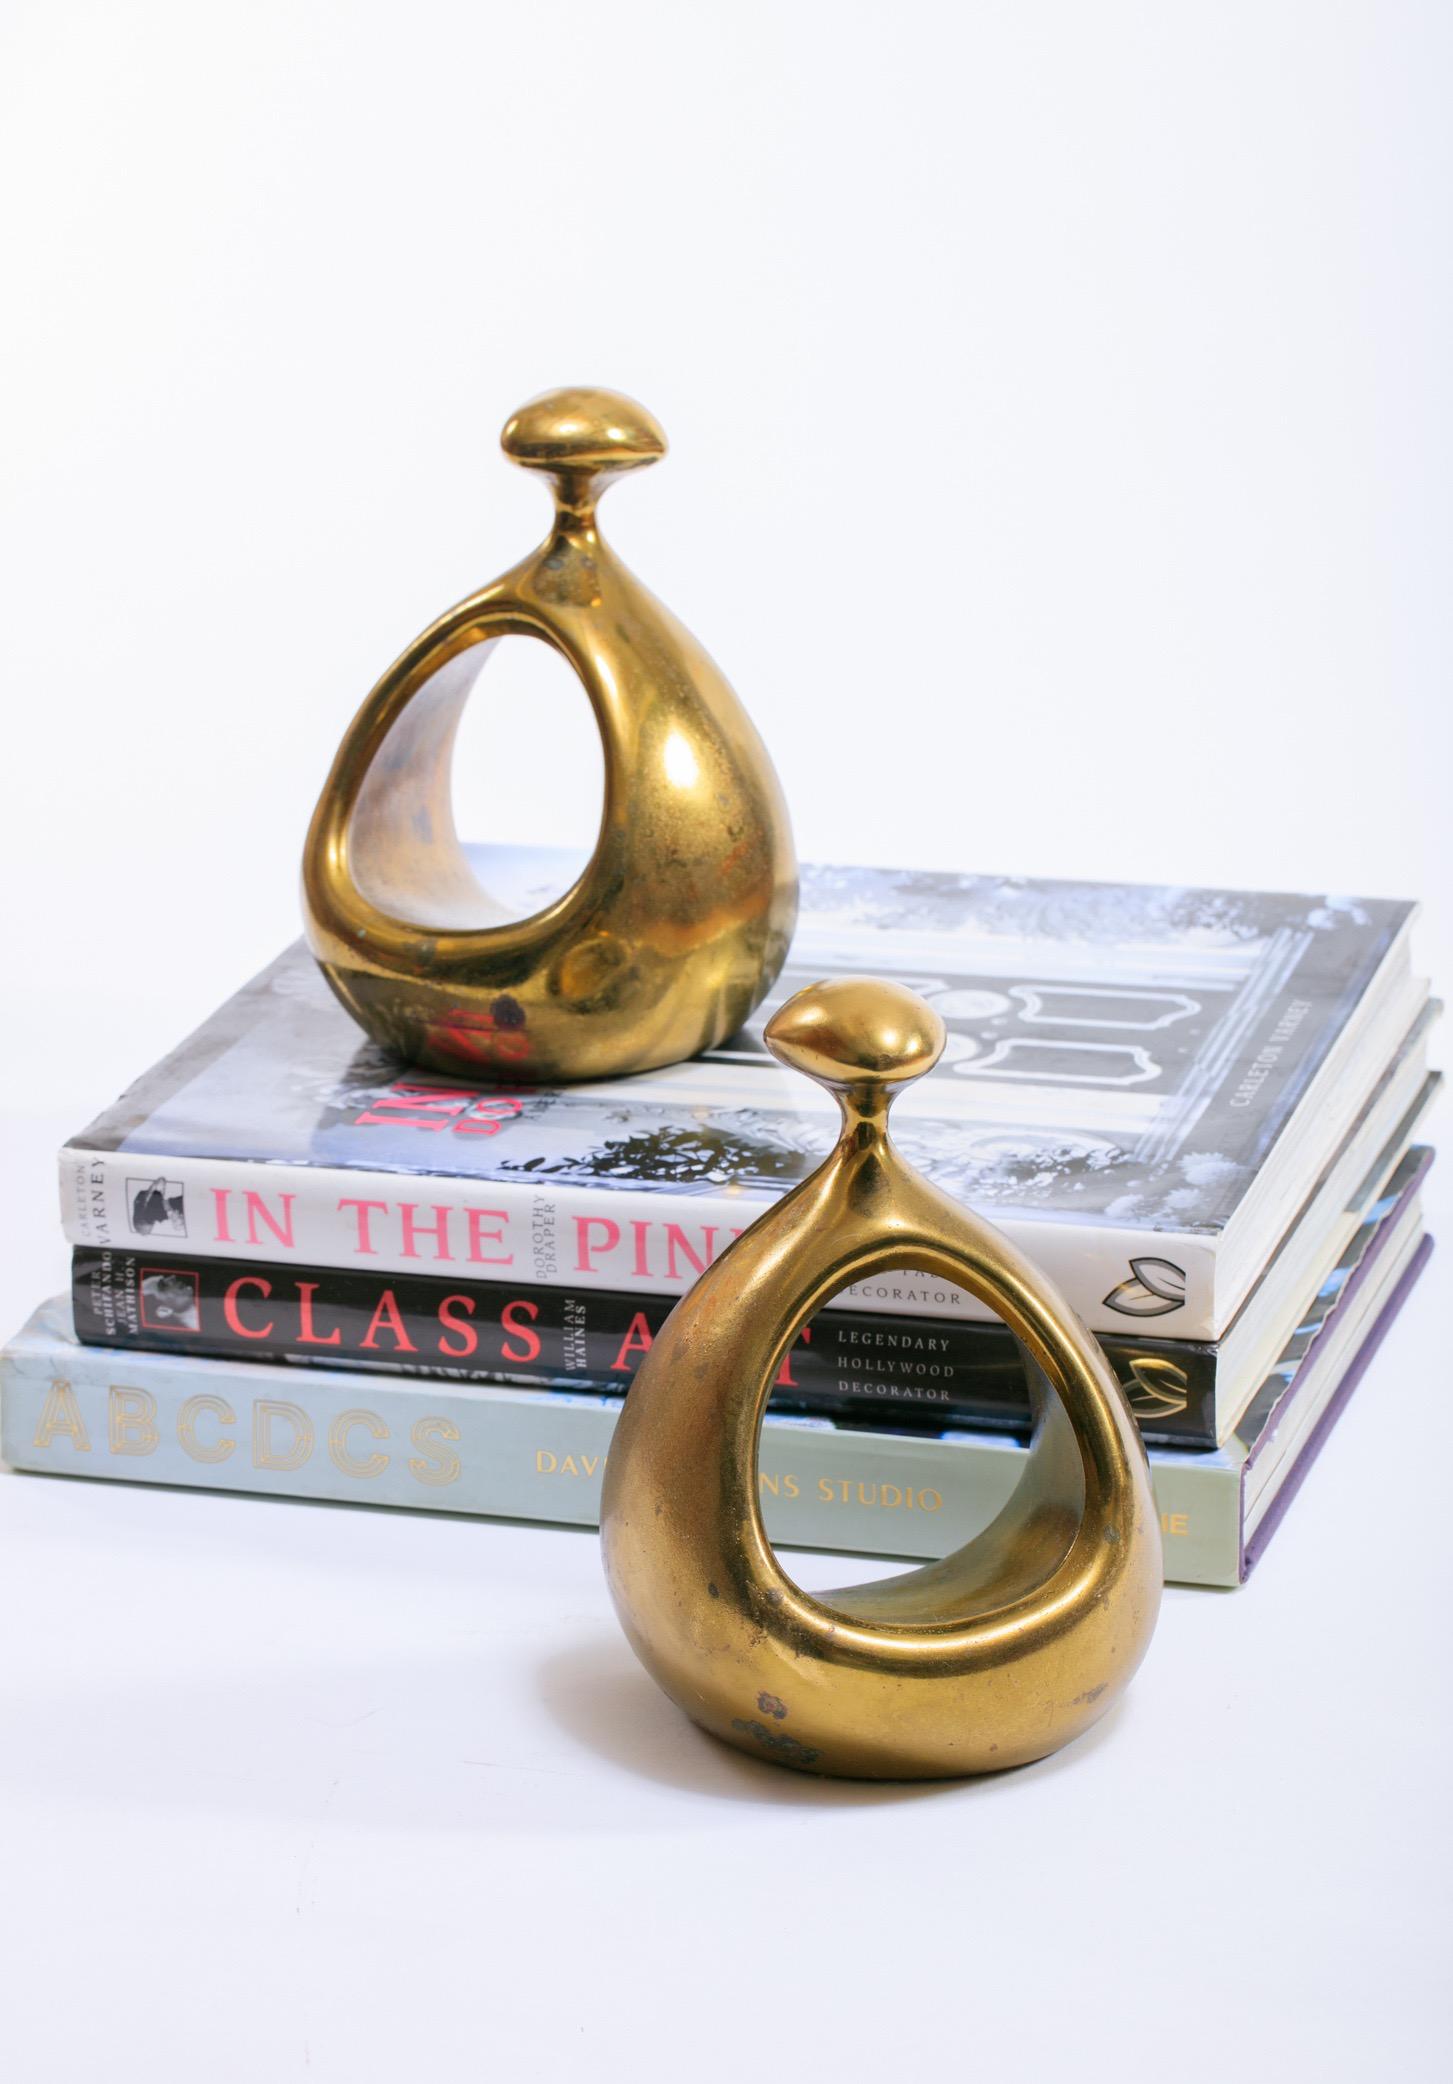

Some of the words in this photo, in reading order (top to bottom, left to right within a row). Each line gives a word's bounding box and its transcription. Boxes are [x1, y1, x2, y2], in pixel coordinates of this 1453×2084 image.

[1230, 1046, 1284, 1107] CARLETON
[1268, 1000, 1312, 1042] VARNEY
[355, 1082, 480, 1132] IN
[76, 1165, 91, 1237] CARLETON
[91, 1158, 112, 1245] VARNEY
[210, 1187, 297, 1249] IN
[336, 1199, 514, 1266] THE
[571, 1216, 744, 1280] PIN
[532, 1194, 547, 1280] DOROTHY
[543, 1203, 557, 1274] DRAPER
[91, 1271, 103, 1315] PETER
[101, 1251, 116, 1336] SCHIFANDO
[114, 1288, 127, 1323] JEAN
[125, 1257, 138, 1335] MATHISON
[223, 1276, 542, 1363] CLASS
[848, 1285, 961, 1305] ECORATOR
[563, 1300, 576, 1371] WILLIAM
[574, 1304, 587, 1369] HAINES
[837, 1356, 955, 1378] HOLLYWOOD
[838, 1330, 951, 1352] LEGENDARY
[839, 1380, 951, 1401] DECORATOR
[32, 1379, 463, 1487] ABCDCS
[536, 1450, 608, 1477] DAV
[818, 1477, 943, 1512] STUDIO
